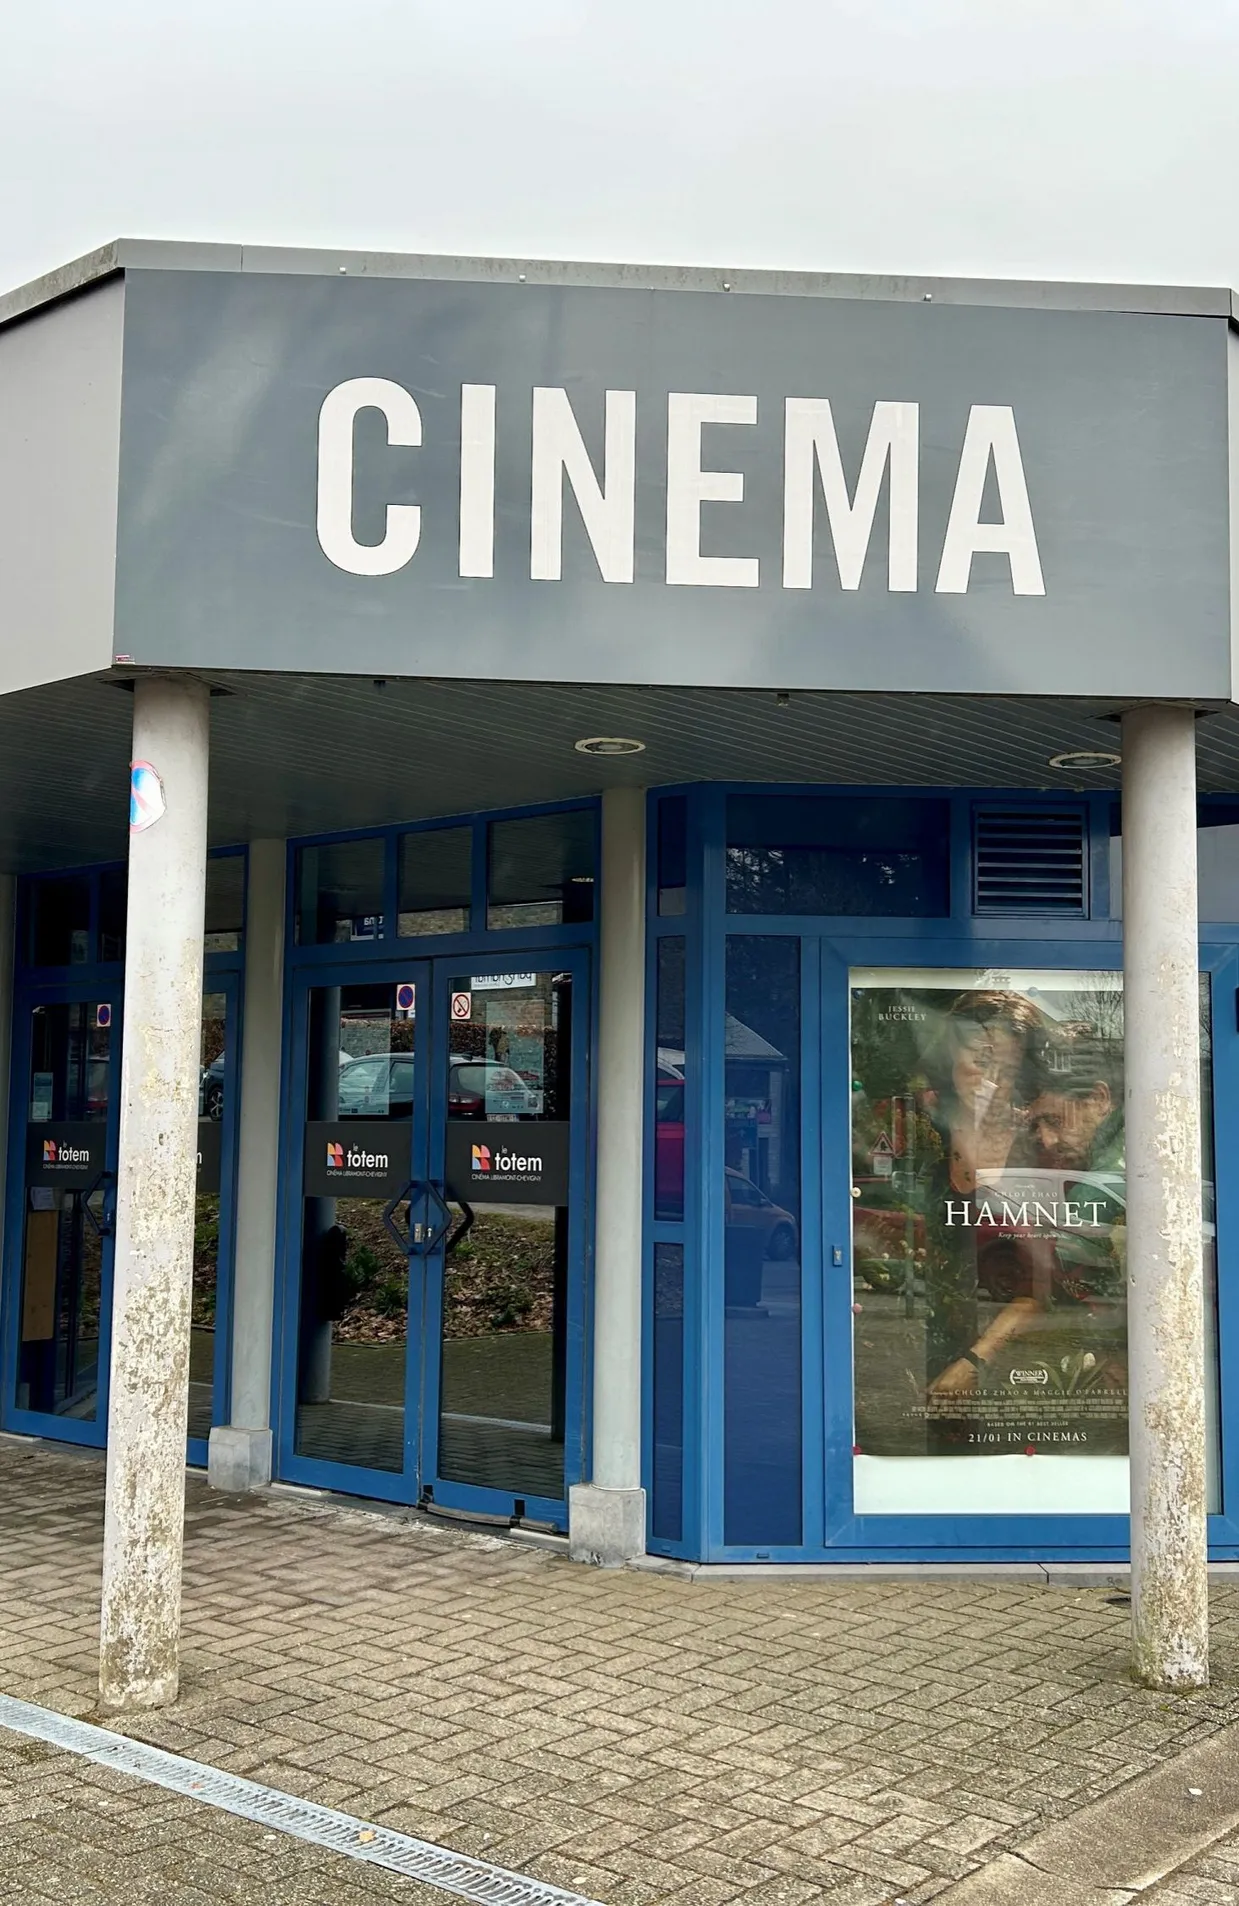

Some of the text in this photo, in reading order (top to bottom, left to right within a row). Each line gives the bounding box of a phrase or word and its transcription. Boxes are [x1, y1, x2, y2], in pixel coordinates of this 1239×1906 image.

[316, 376, 1046, 596] CINEMA
[888, 1005, 916, 1013] JESSIE
[878, 1013, 927, 1021] BUCKLEY
[352, 1142, 359, 1152] le
[501, 1145, 508, 1154] le
[58, 1146, 90, 1162] totem
[346, 1150, 389, 1168] totem
[494, 1152, 543, 1172] totem
[944, 1200, 1107, 1228] HAMNET
[998, 1231, 1012, 1240] Keep
[1026, 1231, 1042, 1239] heart
[993, 1389, 1020, 1397] ZHAO
[968, 1432, 1088, 1443] 21/01 IN CINEMAS
